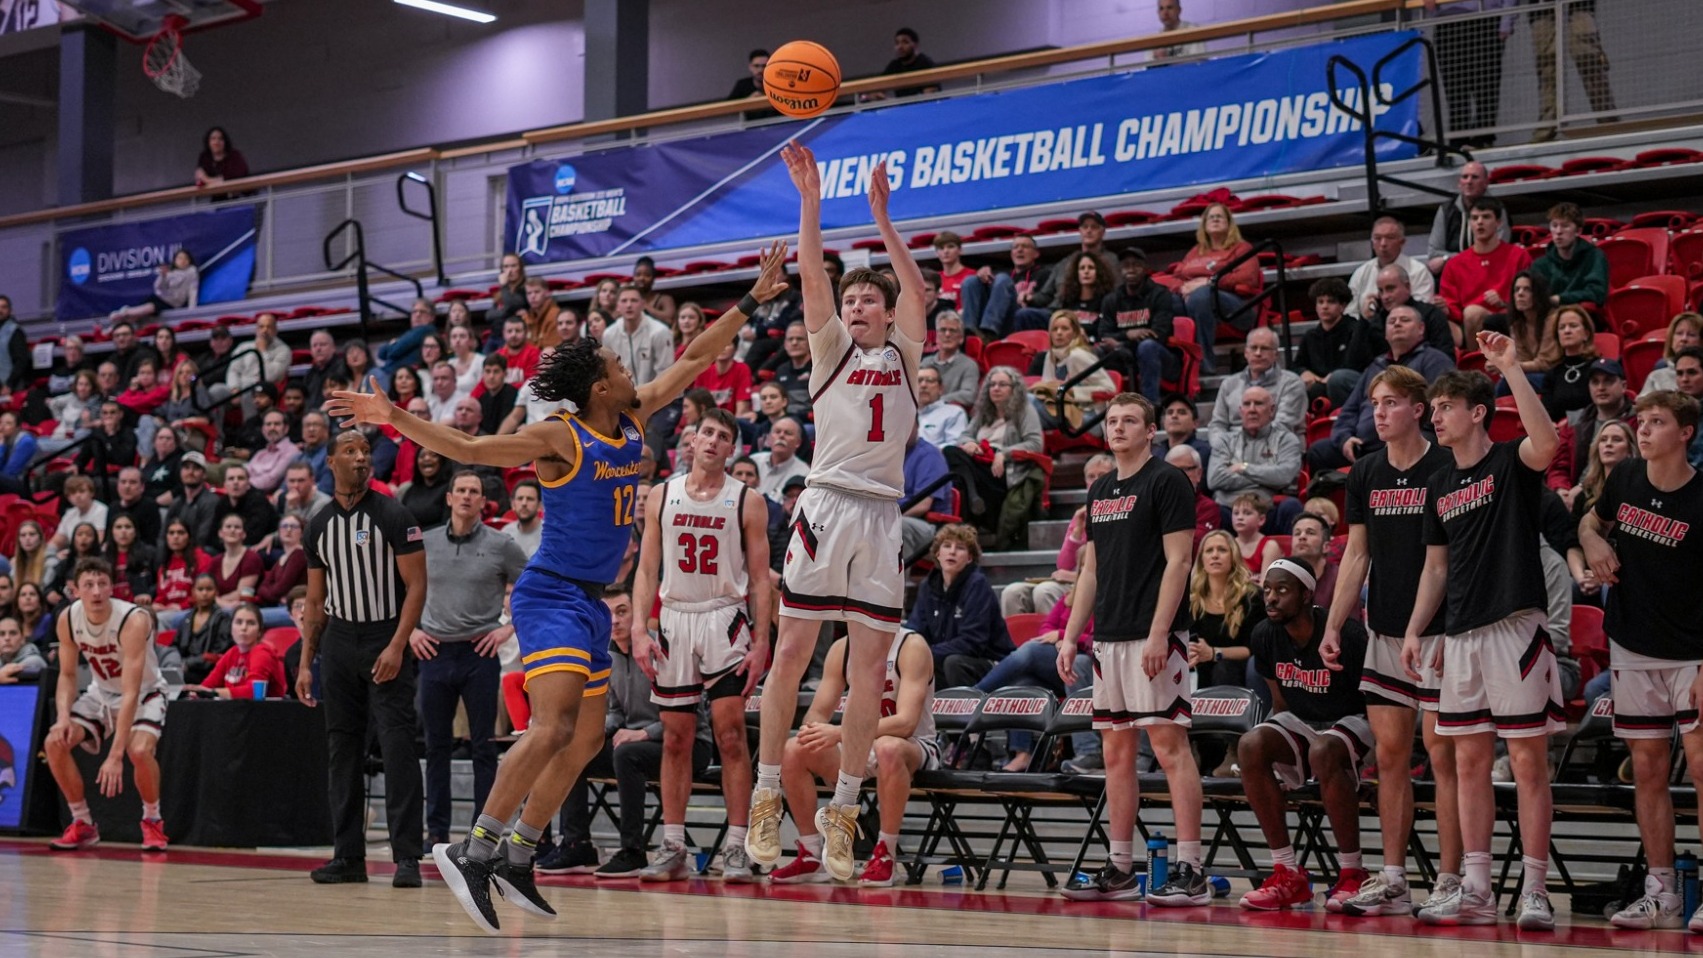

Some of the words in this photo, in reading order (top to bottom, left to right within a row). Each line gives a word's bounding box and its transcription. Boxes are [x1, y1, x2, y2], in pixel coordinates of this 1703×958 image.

[769, 90, 819, 109] Wilson
[910, 123, 1105, 189] BASKETBALL
[1114, 82, 1393, 163] CHAMPIONSHIP
[551, 197, 626, 223] BASKETBALL
[549, 218, 612, 238] CHAMPIONSHIP
[97, 245, 166, 274] DIVISION
[867, 392, 885, 442] 1
[613, 484, 634, 527] 12
[1091, 495, 1137, 516] CATHLC
[1369, 487, 1428, 508] CATHOLI
[1436, 474, 1495, 517] CATHOLIC
[1442, 493, 1494, 523] BASKETBALL
[672, 513, 727, 530] CATHOLIC
[1374, 506, 1425, 516] BASKETBAL
[1617, 502, 1690, 541] CATHOLIC
[1619, 522, 1678, 548] BASKETBALL
[677, 532, 719, 576] 32
[89, 656, 123, 681] 12
[932, 697, 981, 715] ATHOLIC
[982, 697, 1049, 715] CATHOLIC
